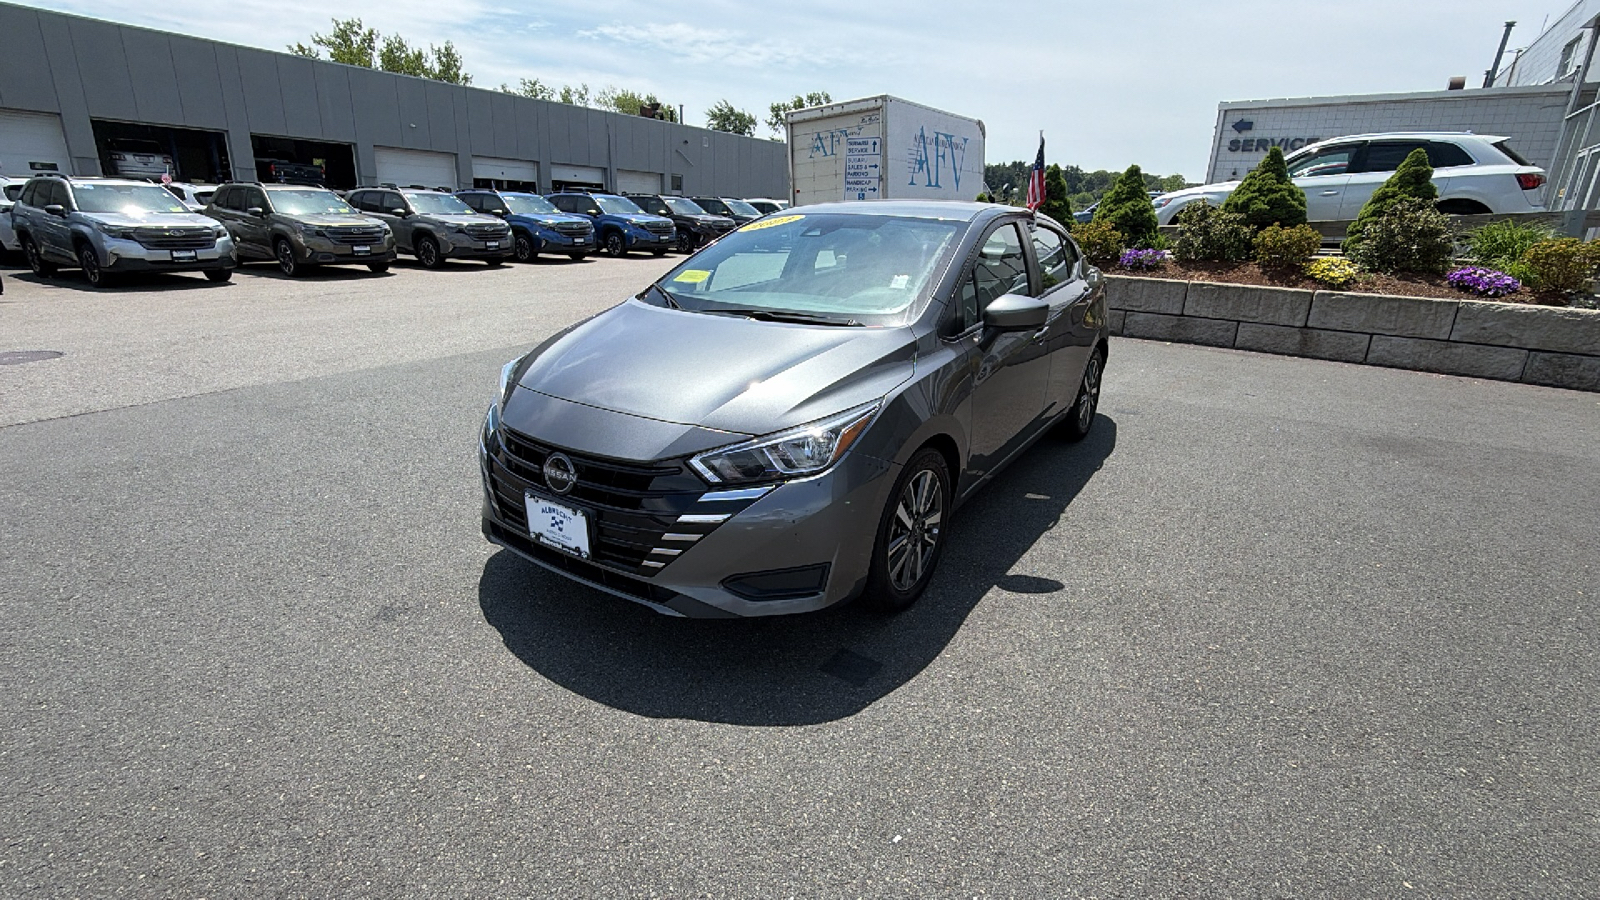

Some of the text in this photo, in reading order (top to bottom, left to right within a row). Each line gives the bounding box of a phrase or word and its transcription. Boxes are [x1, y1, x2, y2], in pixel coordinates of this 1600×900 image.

[908, 125, 969, 192] AFV
[543, 464, 578, 482] NISSAN
[541, 506, 573, 524] ALBRECHT
